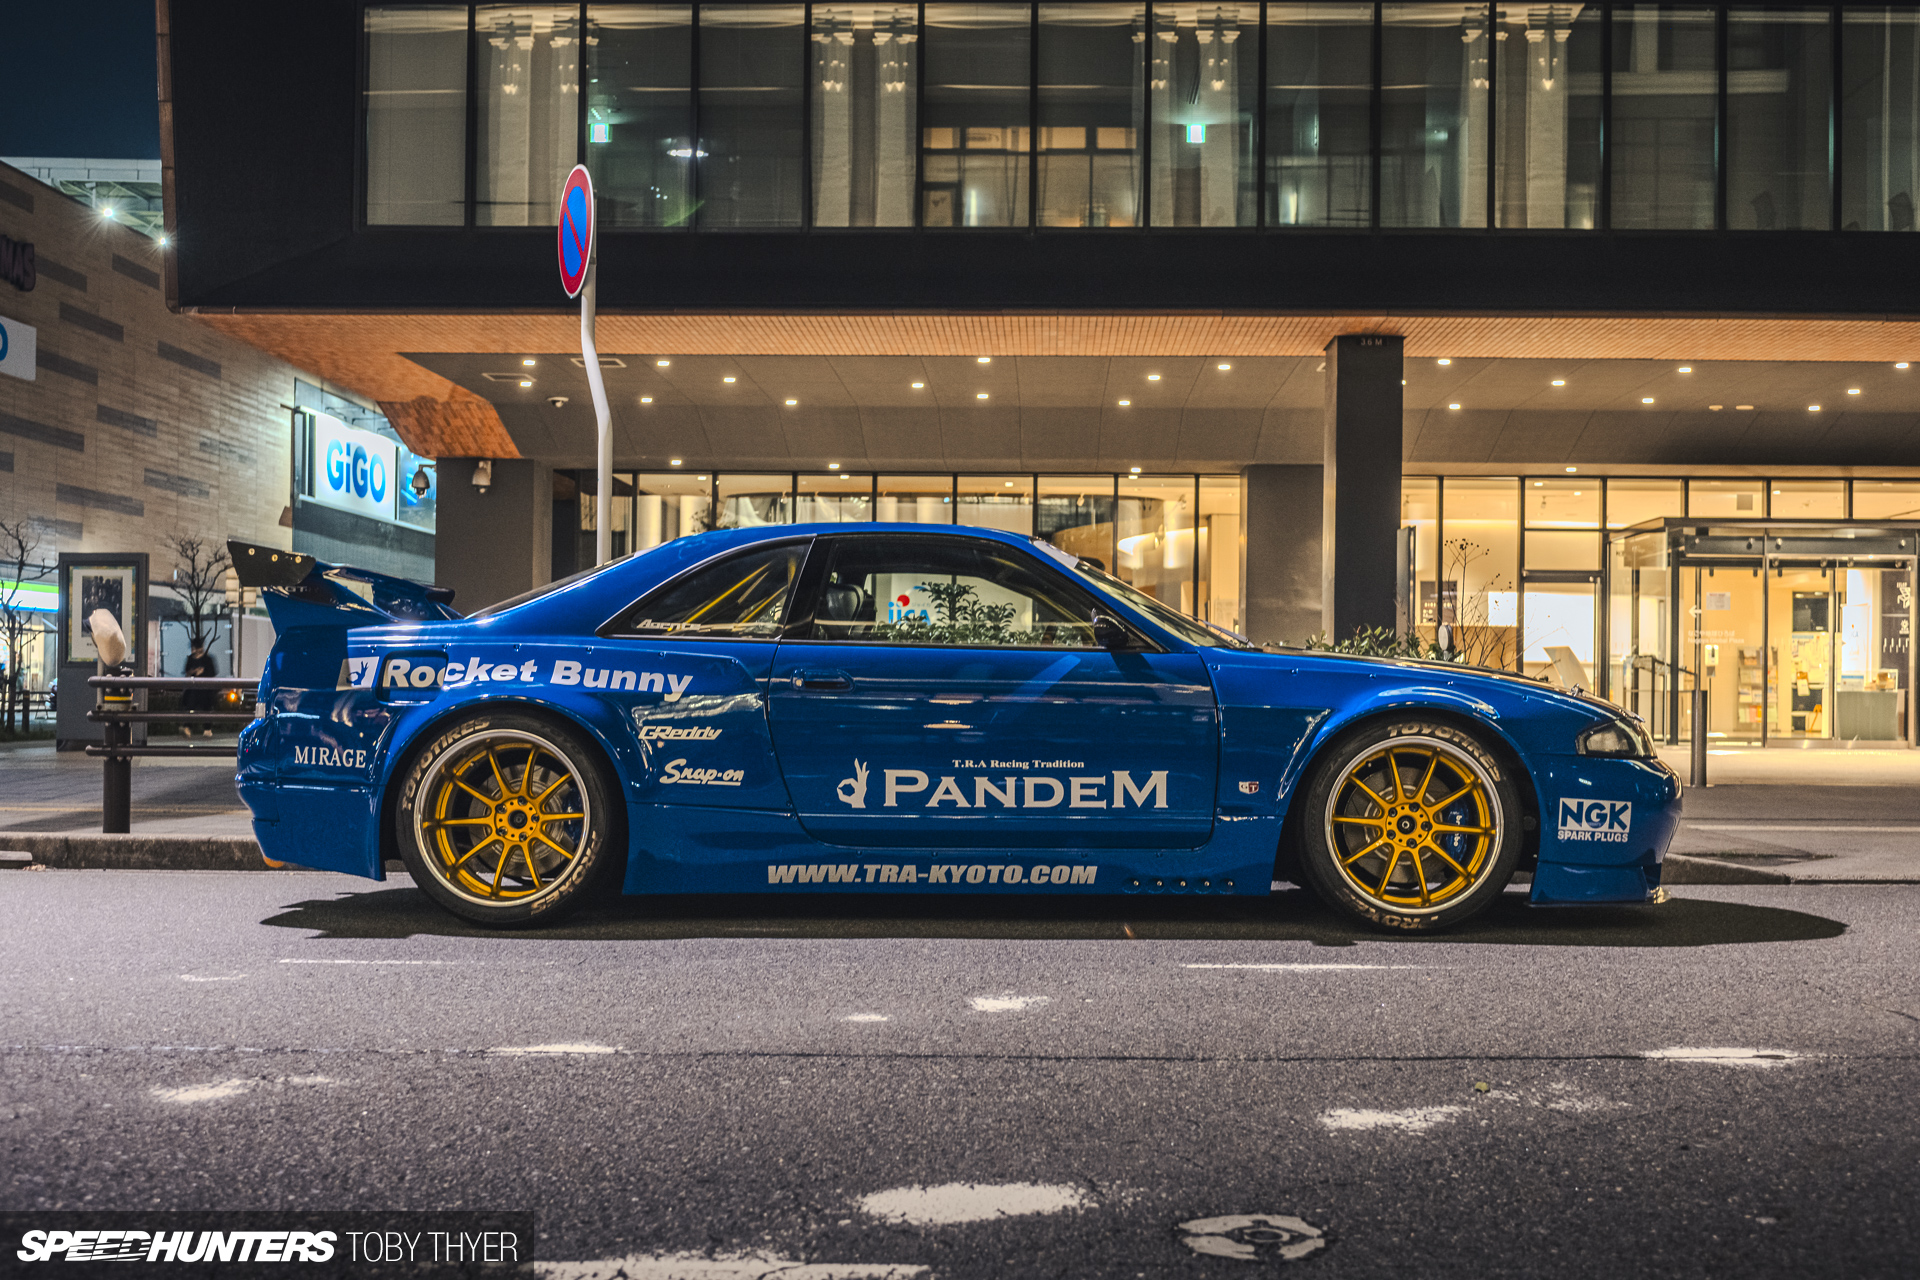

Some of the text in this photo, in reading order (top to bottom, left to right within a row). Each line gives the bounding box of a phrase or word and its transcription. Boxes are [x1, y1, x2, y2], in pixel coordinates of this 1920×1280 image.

[382, 656, 693, 702] Rocket Bunny
[638, 726, 723, 740] GReddy
[294, 745, 367, 768] MIRAGE
[952, 759, 1085, 770] T.R.A Racing Tradition
[659, 758, 745, 784] Snap-on
[884, 769, 1169, 809] PANDEM
[1560, 799, 1631, 832] NGK
[1453, 814, 1463, 847] brbo
[1558, 830, 1629, 843] SPARK PLUGS
[767, 864, 1098, 884] WWW.TRA-KYOTO.COM
